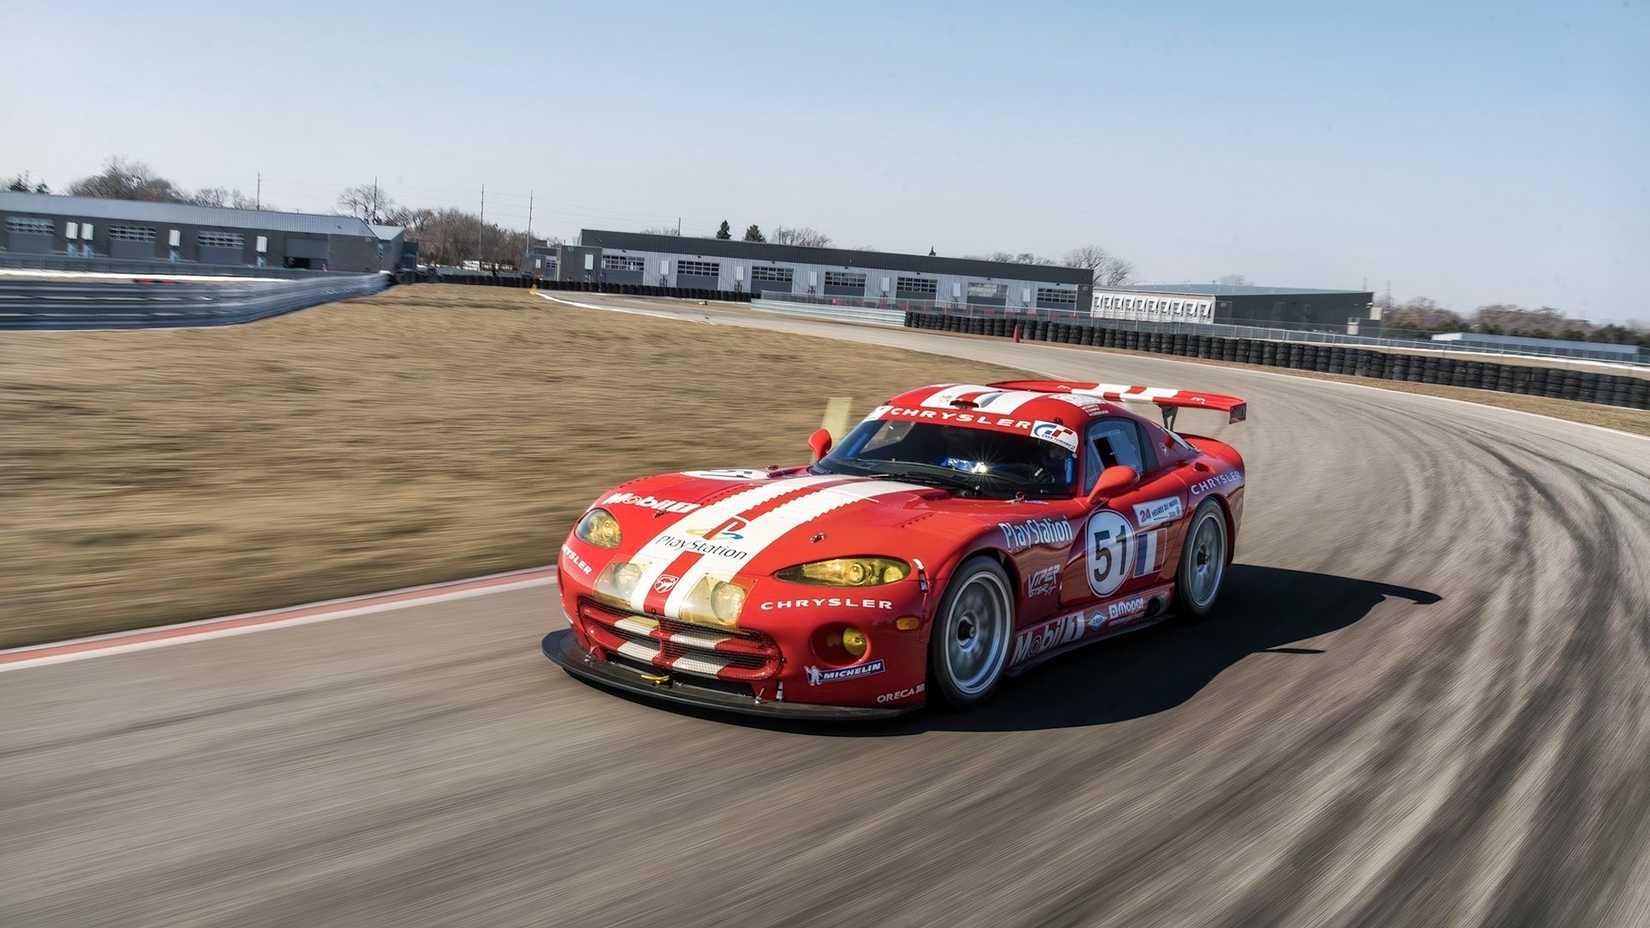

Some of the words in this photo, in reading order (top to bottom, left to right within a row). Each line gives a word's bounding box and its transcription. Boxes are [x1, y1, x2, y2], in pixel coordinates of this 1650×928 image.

[890, 408, 1032, 430] CHRYSLER
[1190, 469, 1242, 495] CHRYSLER
[1140, 508, 1151, 522] 24
[998, 516, 1073, 550] PlayStation
[1094, 525, 1127, 582] 51
[760, 598, 893, 610] CHRYSLER
[823, 662, 882, 680] MICHELIN
[877, 687, 914, 703] ORECA
